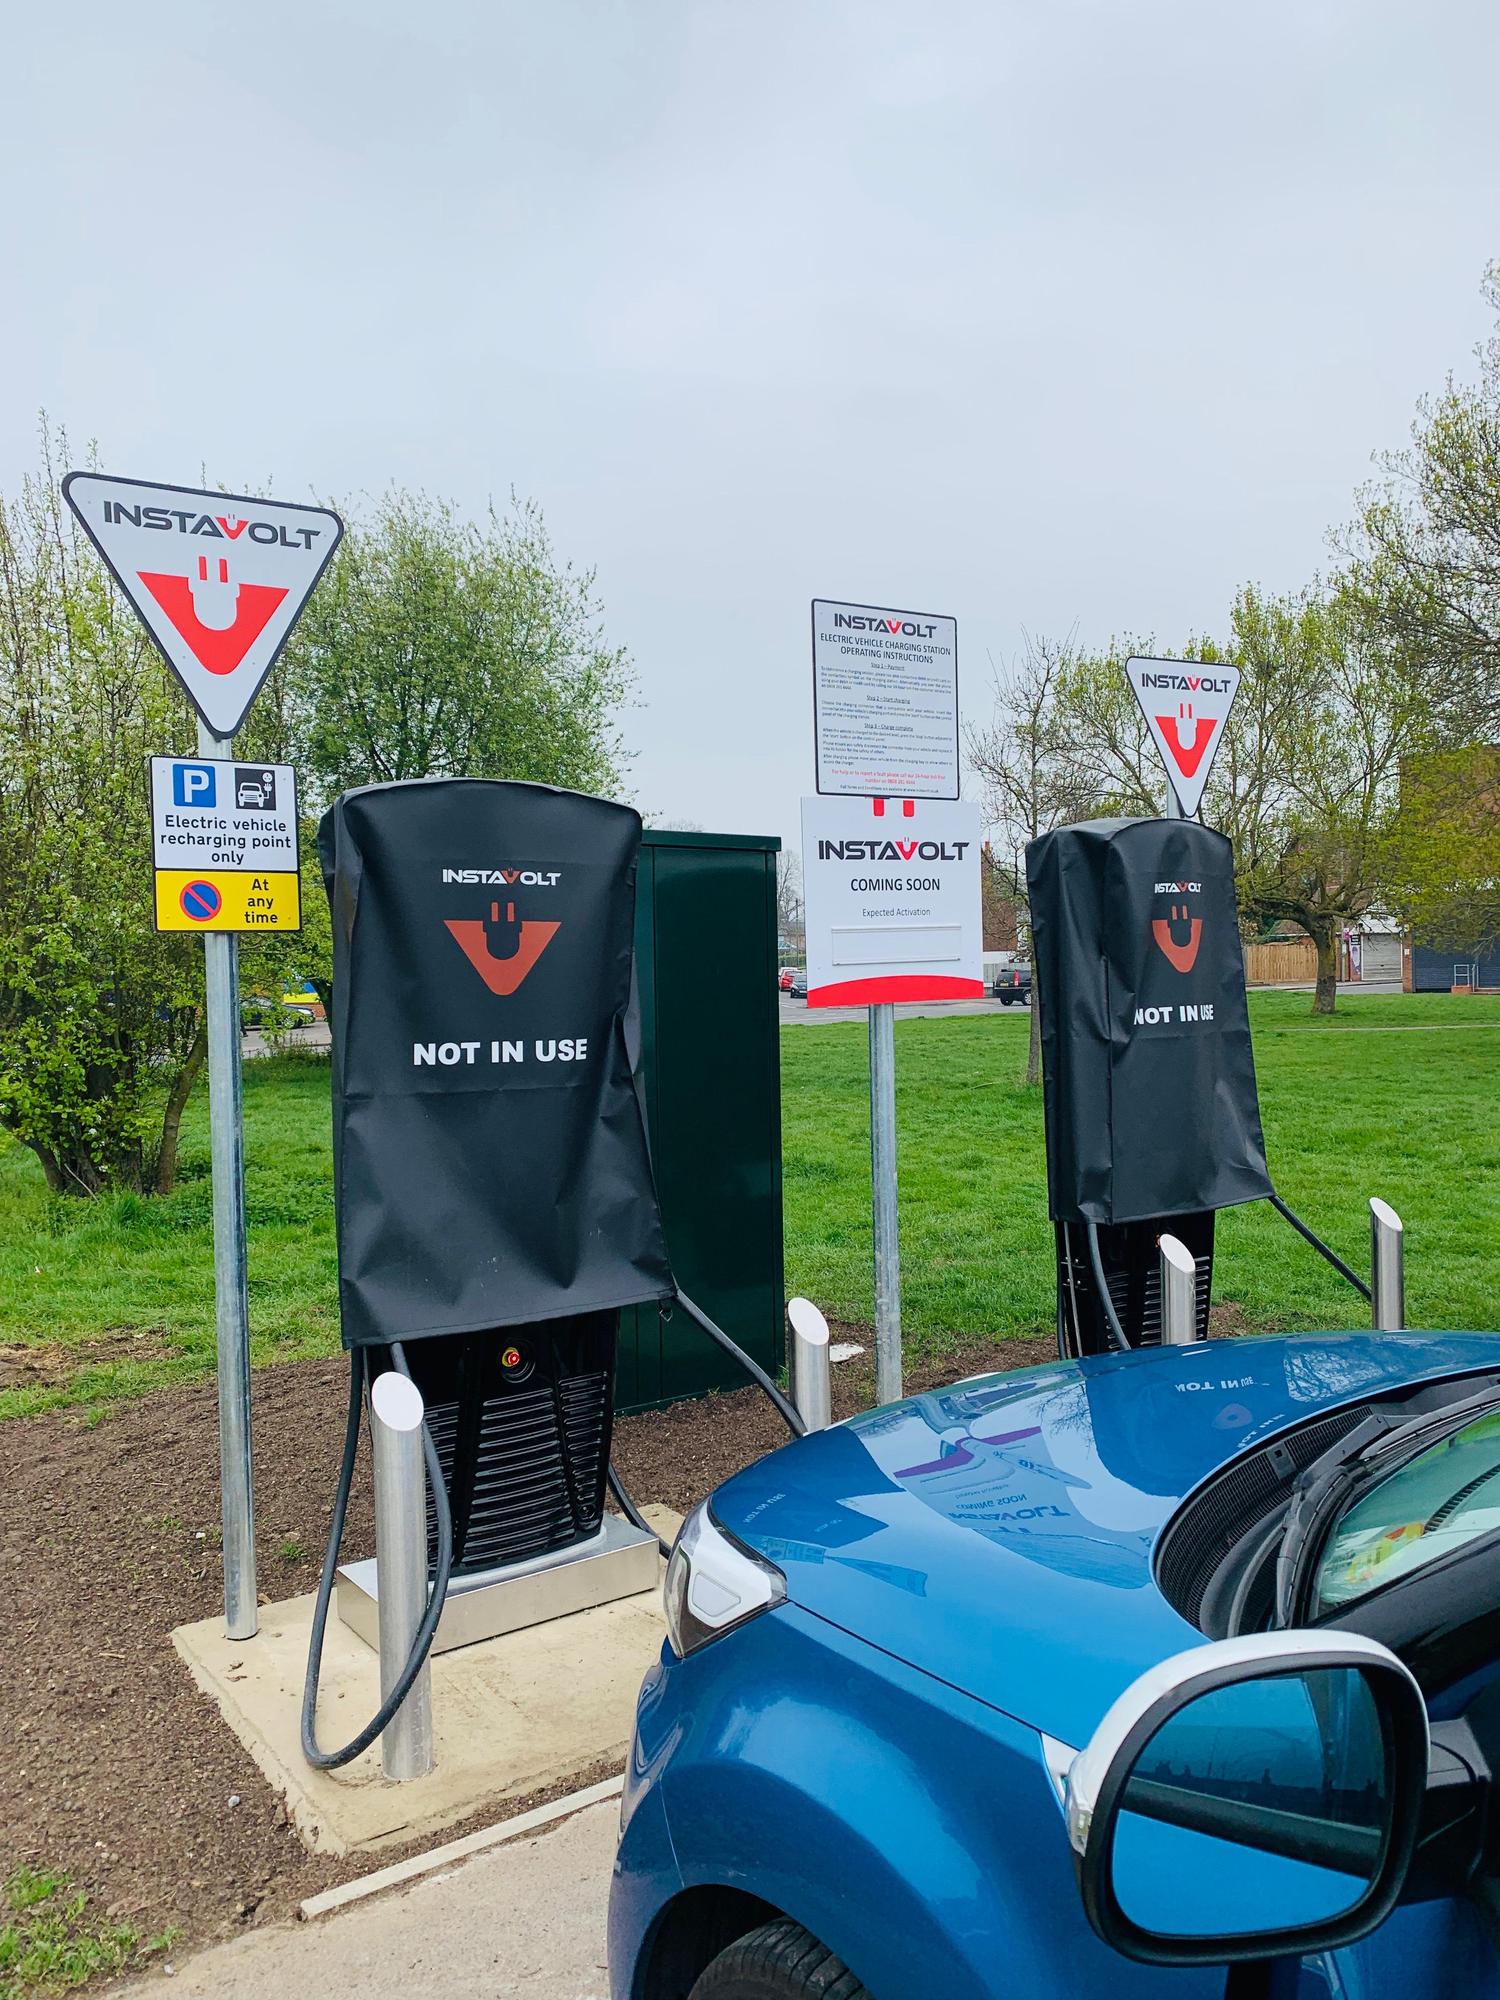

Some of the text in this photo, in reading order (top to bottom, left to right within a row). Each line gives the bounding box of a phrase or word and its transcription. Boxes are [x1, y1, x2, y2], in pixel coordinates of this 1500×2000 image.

[103, 500, 320, 550] INSTAVOLT
[834, 613, 937, 638] INSTAVOLT
[820, 633, 951, 655] ELECTRIC VEHICLE CHARGING STATION
[841, 646, 934, 664] OPERATING INSTRUCTIONS
[1141, 673, 1231, 694] INSTAVOLT
[184, 769, 209, 803] P
[165, 814, 287, 832] Electric vehicle
[161, 832, 291, 849] recharging point
[818, 837, 969, 861] INSTAVOLT
[211, 850, 245, 865] only
[251, 878, 269, 891] At
[442, 867, 561, 886] INSTAVOLT
[850, 878, 940, 892] COMING SOON
[247, 897, 274, 910] any
[244, 911, 278, 924] time
[862, 908, 931, 918] Expected Activation
[1133, 1004, 1214, 1025] NOT IN USE
[413, 1038, 588, 1066] NOT IN USE
